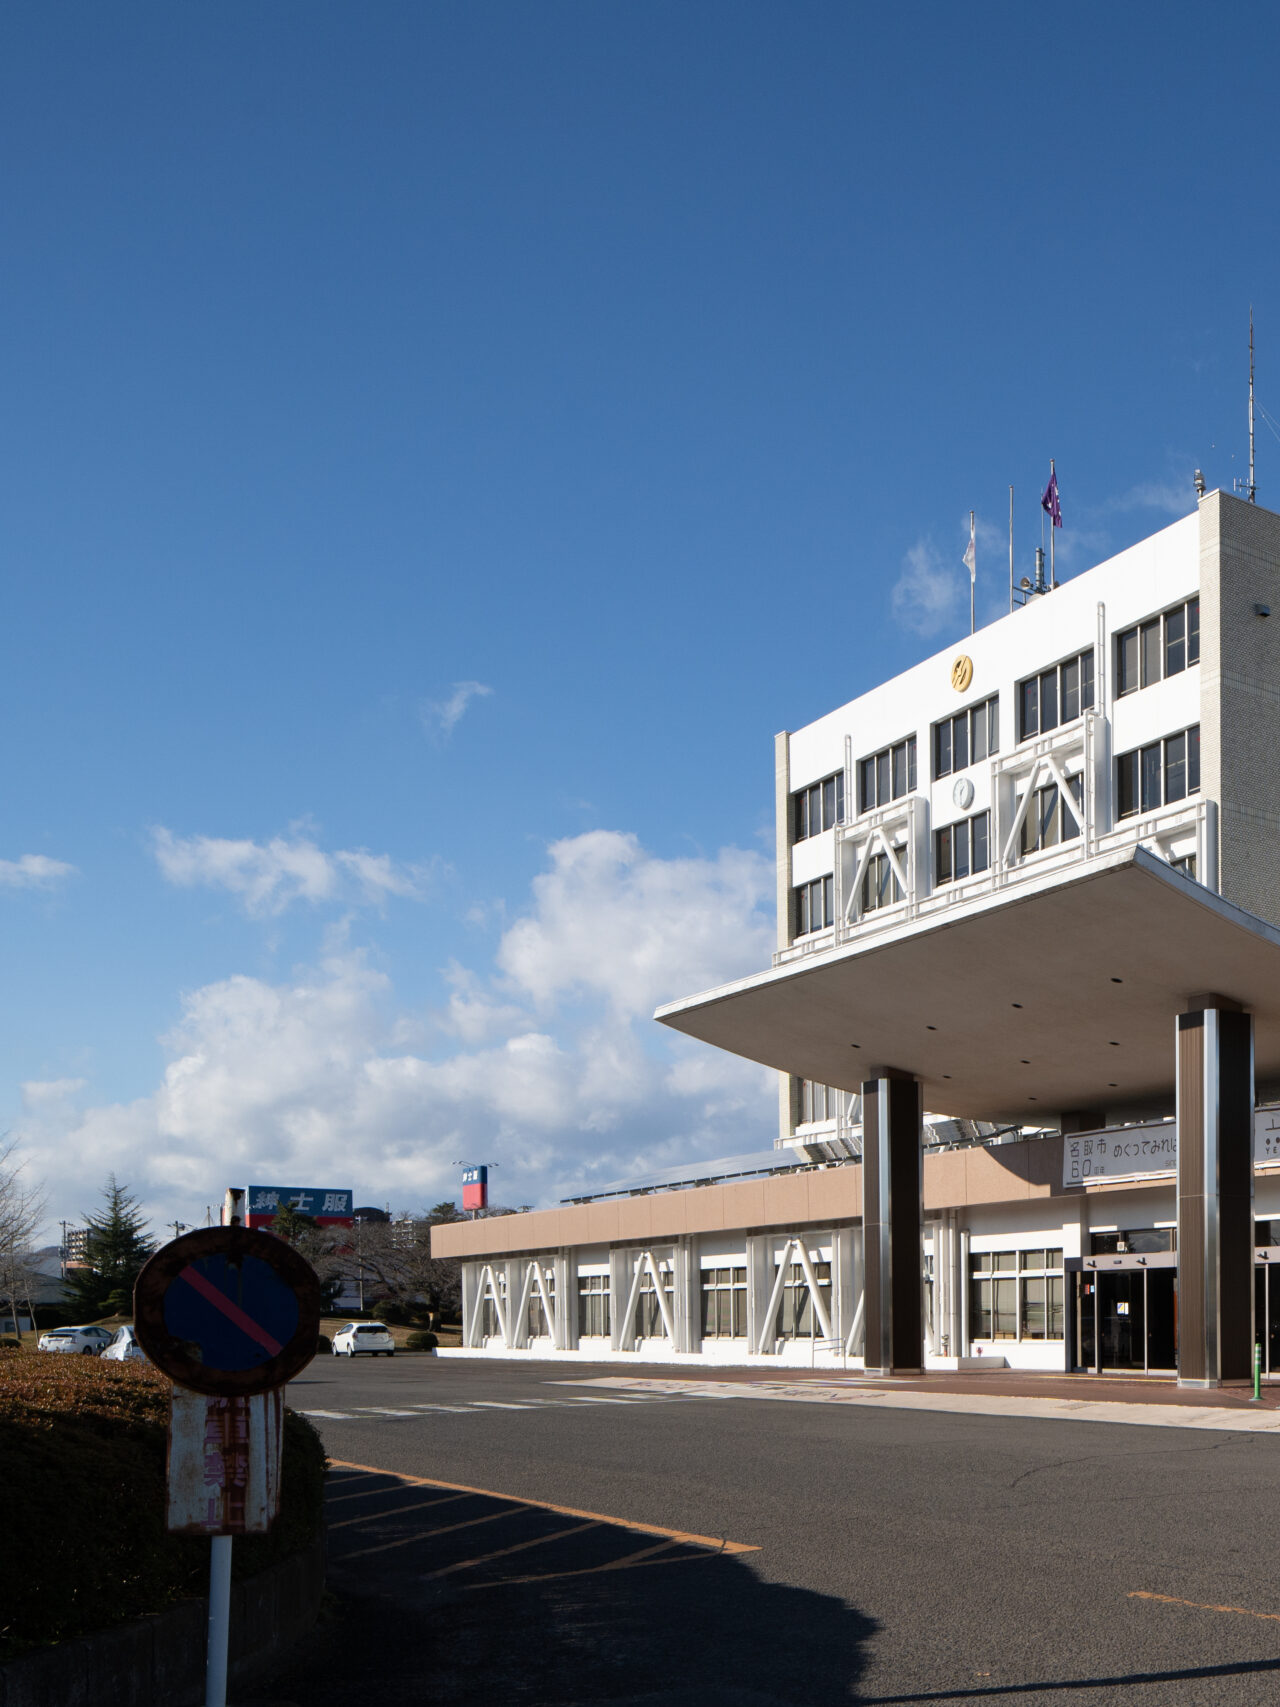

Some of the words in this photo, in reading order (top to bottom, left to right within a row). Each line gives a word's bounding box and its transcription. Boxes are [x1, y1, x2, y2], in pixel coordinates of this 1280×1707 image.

[1070, 1138, 1107, 1158] 名取市
[255, 1192, 348, 1212] 紳士服
